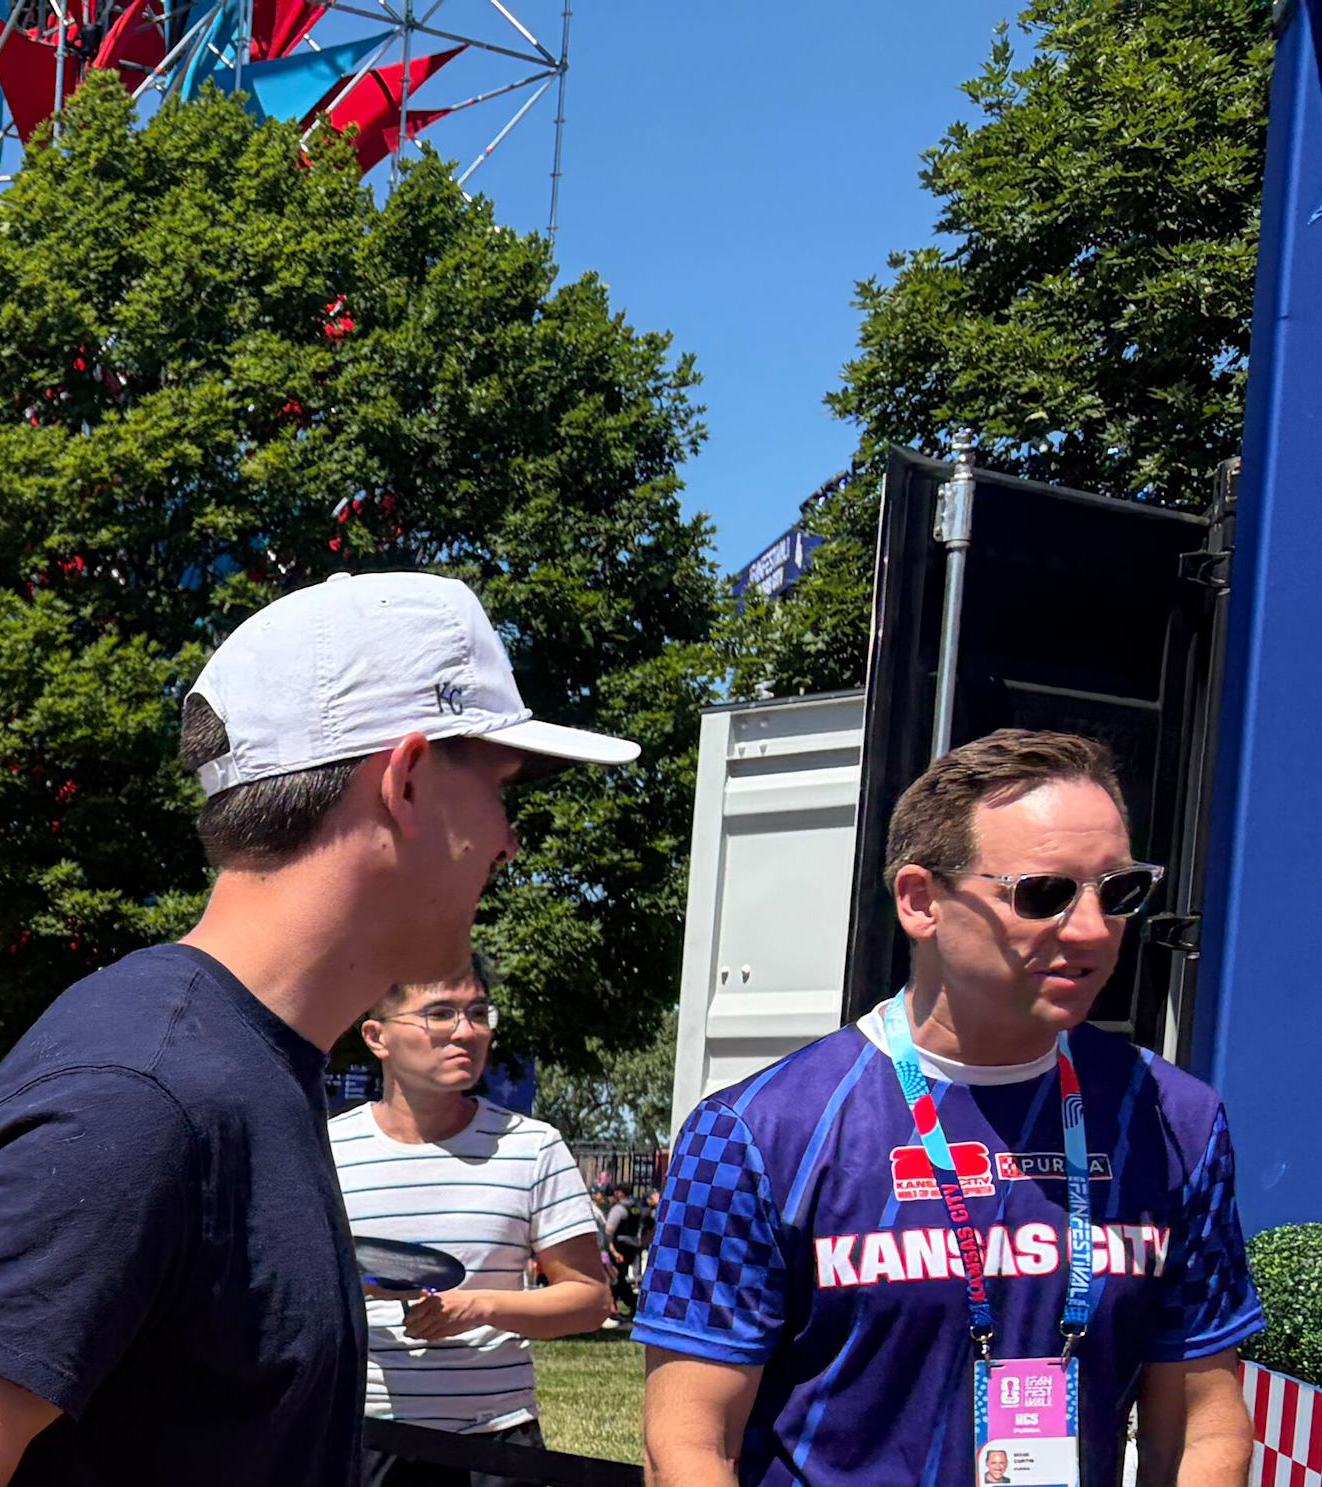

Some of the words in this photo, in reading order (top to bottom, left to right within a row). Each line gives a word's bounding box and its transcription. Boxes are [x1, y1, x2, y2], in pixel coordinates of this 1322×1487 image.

[434, 681, 463, 716] KC
[1021, 1158, 1104, 1173] PURA
[940, 1184, 970, 1223] CITY
